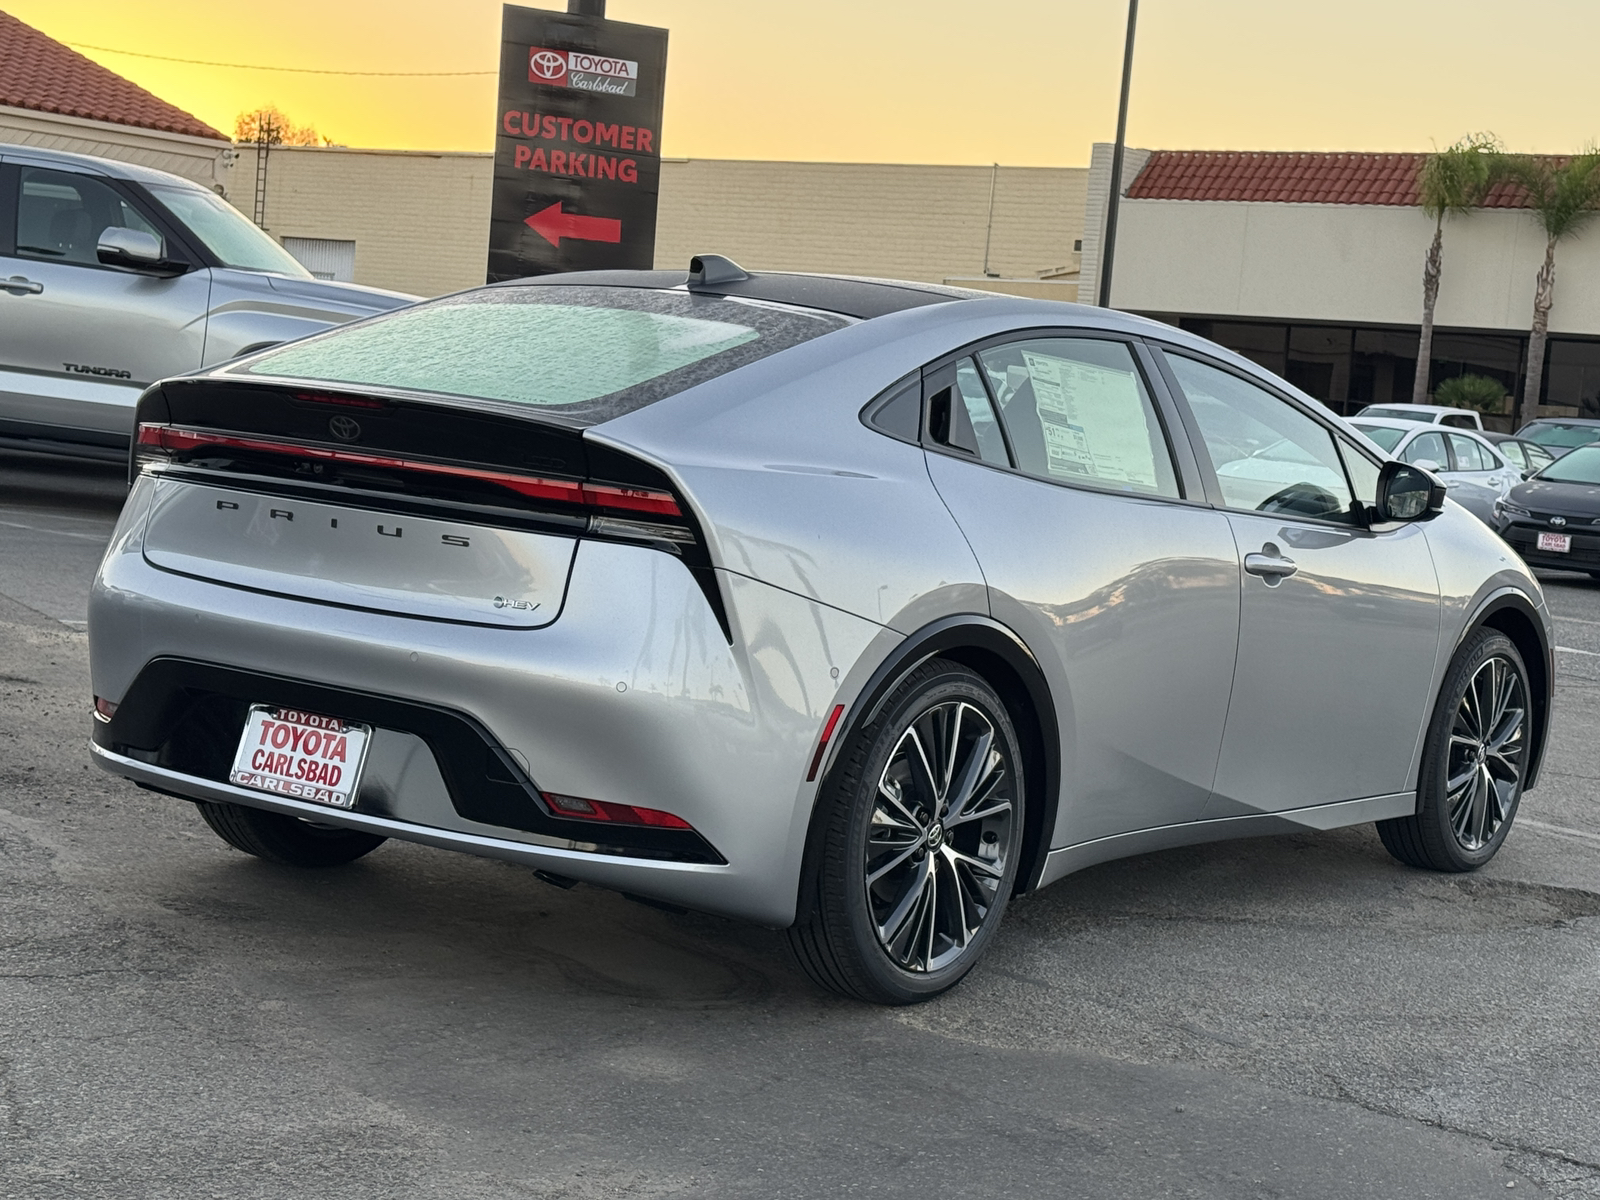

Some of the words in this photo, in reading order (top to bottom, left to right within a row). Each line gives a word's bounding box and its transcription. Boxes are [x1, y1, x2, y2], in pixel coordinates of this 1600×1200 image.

[573, 55, 629, 76] TOYOTA
[571, 72, 628, 94] Carlsbad
[503, 111, 653, 152] CUSTOMER
[514, 145, 638, 183] PARKING
[62, 362, 132, 379] TUNDRA
[216, 500, 471, 547] PRIUS
[1542, 535, 1566, 544] TOYOTA
[503, 599, 541, 611] HEV
[279, 709, 340, 731] TOYOTA
[260, 720, 347, 763] TOYOTA
[252, 749, 342, 787] CARLSBAD
[236, 772, 346, 805] CARLSBAD
